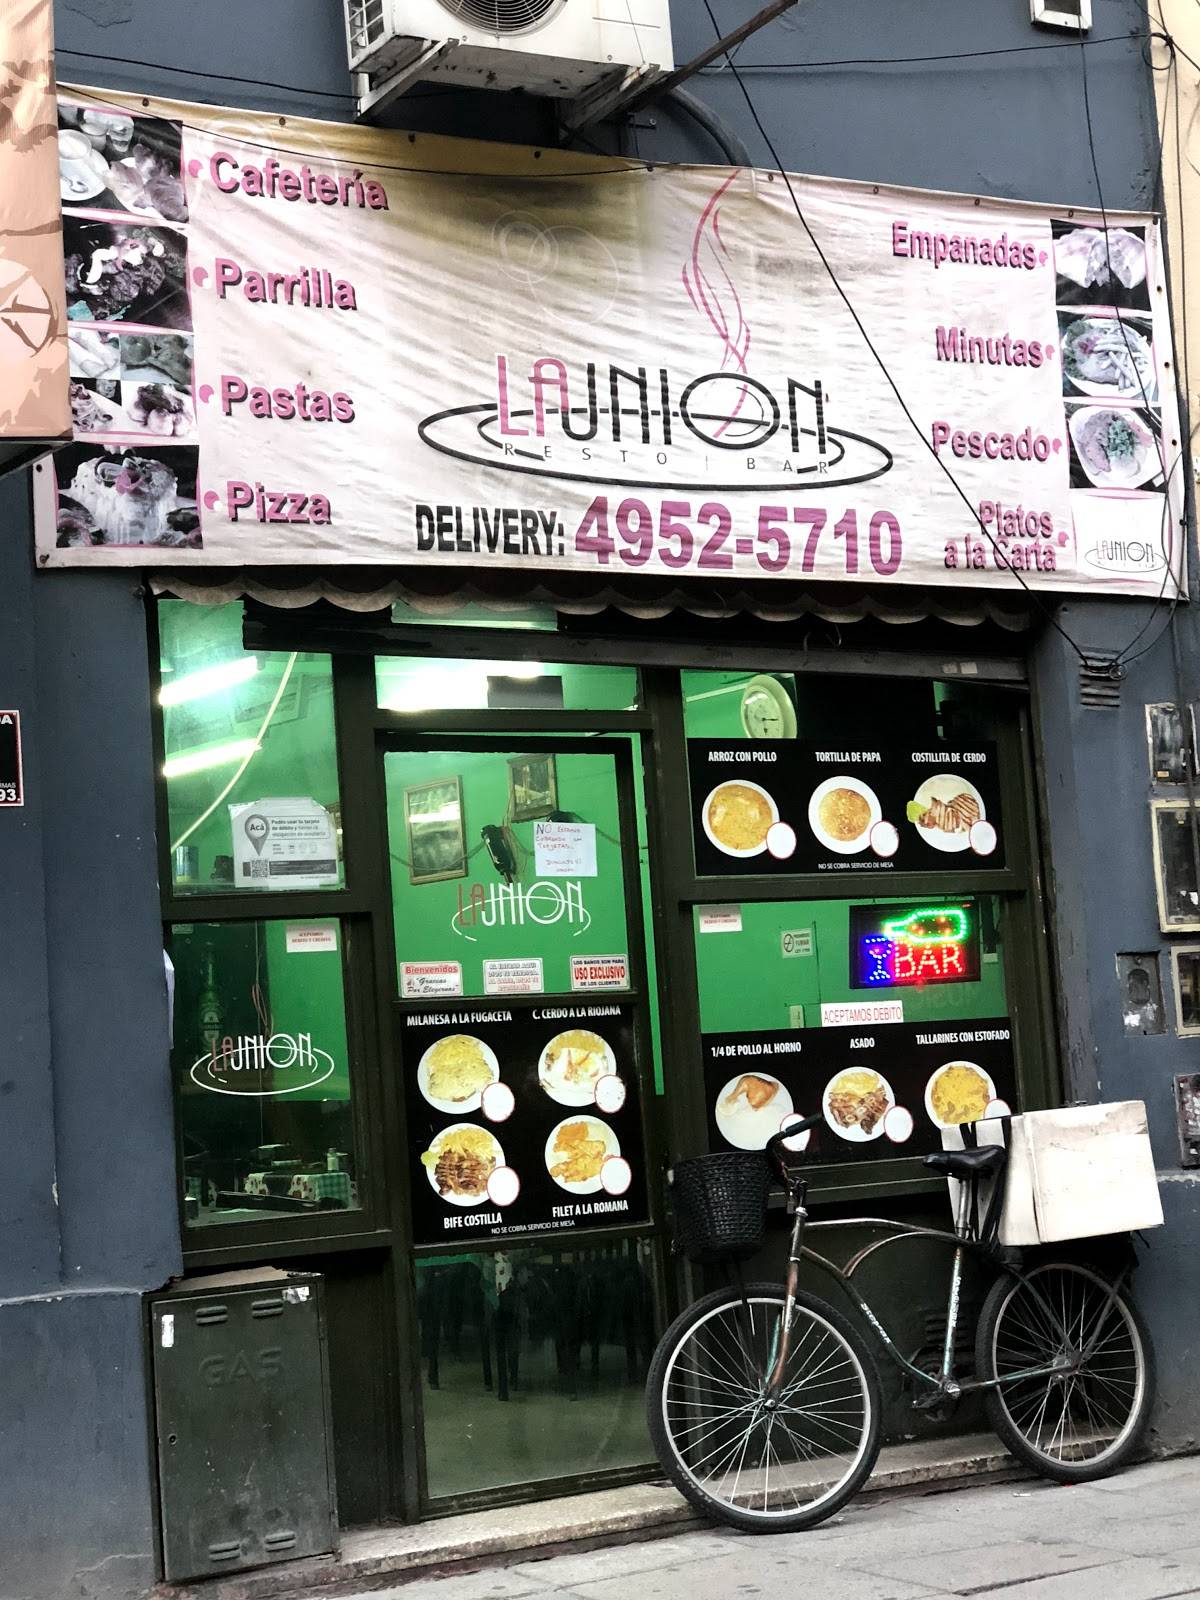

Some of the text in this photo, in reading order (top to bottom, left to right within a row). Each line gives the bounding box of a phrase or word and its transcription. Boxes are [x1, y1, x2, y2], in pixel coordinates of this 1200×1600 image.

[210, 152, 389, 210] Cafetería
[892, 221, 1036, 270] Empanadas
[215, 258, 357, 310] Parrilla
[936, 326, 1044, 368] Minutas
[221, 375, 355, 423] Pastas
[496, 355, 827, 454] LA UNION
[932, 421, 1050, 462] Pescado
[746, 457, 829, 475] BAR
[227, 480, 332, 525] Pizza
[979, 500, 1053, 538] Platos
[415, 496, 903, 576] DELIVERY: 4952-5710
[944, 533, 1056, 571] a la Carta
[1107, 541, 1154, 562] UNION
[0, 714, 13, 724] A
[708, 751, 777, 762] ARROZ CON POLLO
[815, 751, 881, 763] TORTILLA DE PAPA
[911, 752, 986, 763] COSTILLITA DE CERDO
[249, 823, 265, 831] Acá
[536, 823, 552, 834] NO
[481, 881, 584, 926] UNION
[894, 940, 963, 978] BAR
[405, 965, 458, 974] Bienvenidos
[574, 965, 625, 980] USO EXCLUSIVO
[407, 1010, 512, 1026] MILANESA A LA FUGACETA
[532, 1005, 621, 1019] C. CERDO A LA RIOJANA
[823, 1006, 902, 1024] ACEPTAMOS DEBITO
[850, 1037, 875, 1049] ASADO
[916, 1030, 1010, 1045] TALLARINES CON ESTOFADO
[230, 1033, 312, 1071] UNION
[711, 1041, 801, 1057] 1/4 DE POLLO AL HORNO
[552, 1200, 629, 1218] FILET A LA ROMANA
[443, 1212, 502, 1229] BIFE COSTILLA
[508, 1225, 527, 1233] COBRA
[527, 1222, 551, 1231] SERVICIO
[552, 1221, 559, 1229] DE
[560, 1219, 575, 1228] MESA
[199, 1346, 282, 1386] GAS
